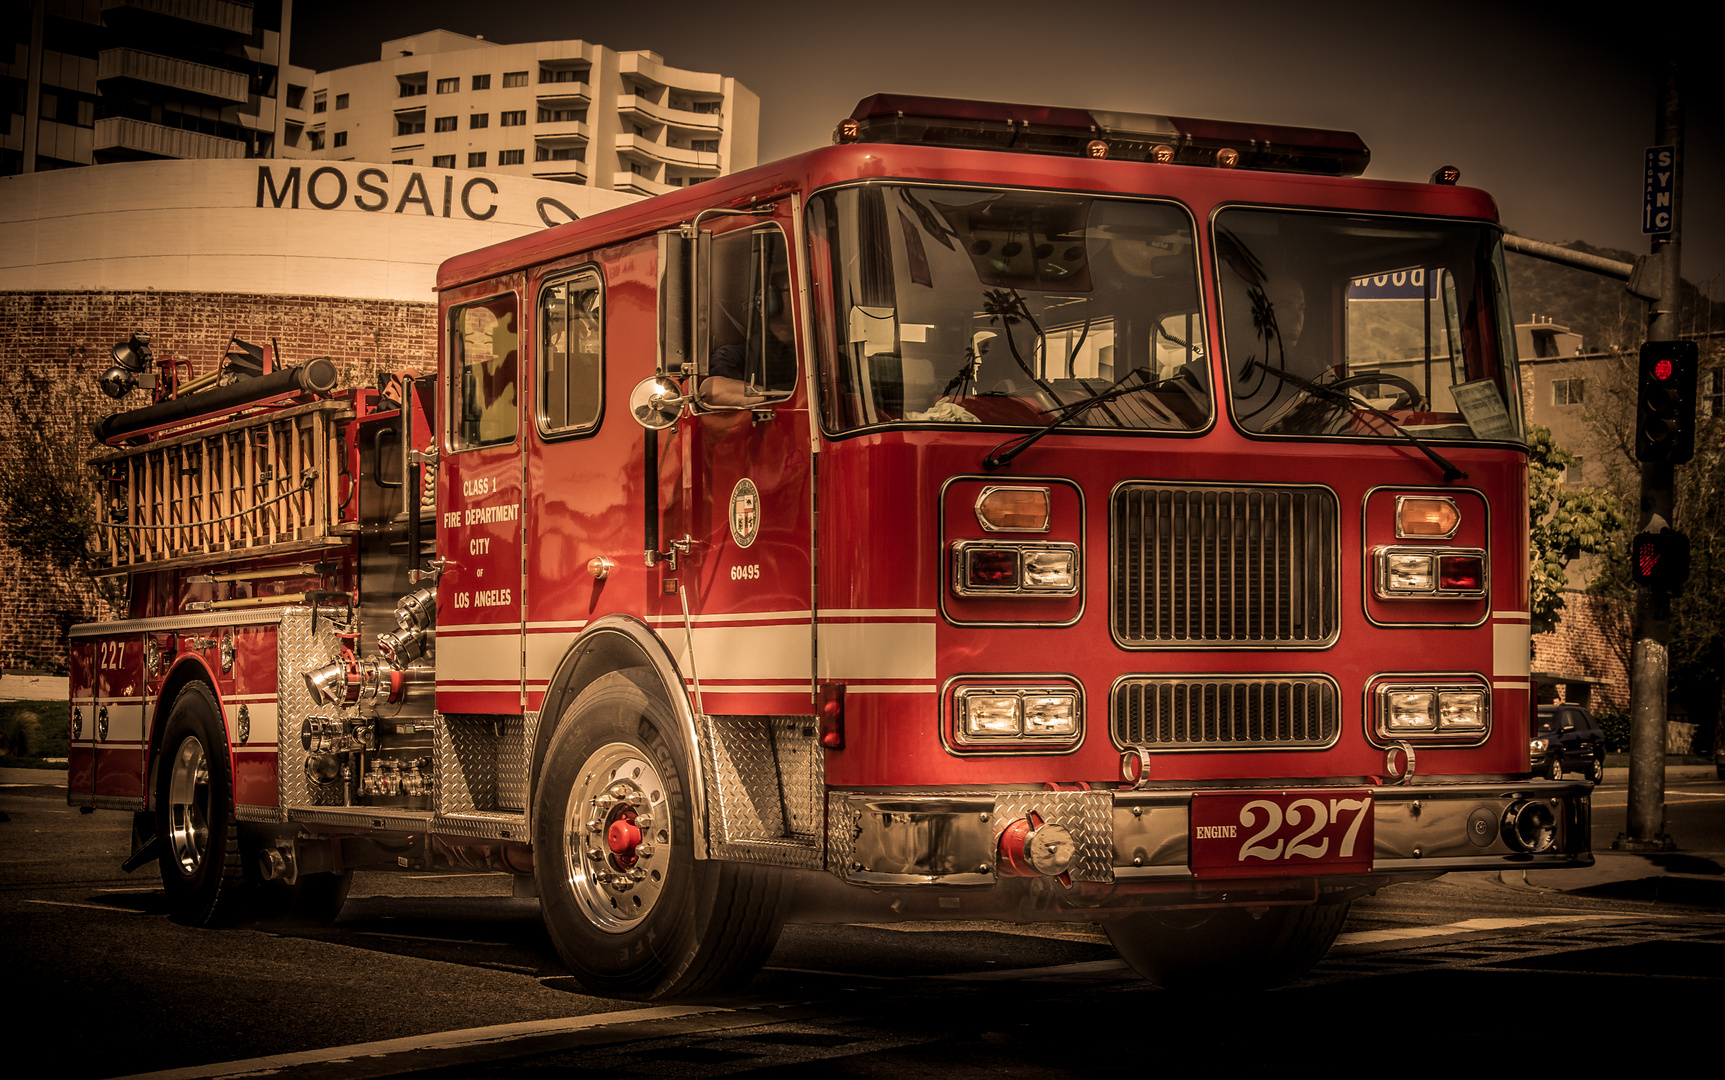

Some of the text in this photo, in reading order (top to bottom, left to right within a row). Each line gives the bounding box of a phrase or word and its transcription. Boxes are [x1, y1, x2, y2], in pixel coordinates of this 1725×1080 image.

[256, 165, 499, 221] MOSAIC
[1655, 151, 1671, 228] SYNC
[463, 476, 497, 497] CLASS 1
[443, 503, 520, 529] FIRE DEPARTMENT
[469, 537, 490, 556] CITY
[476, 568, 484, 578] OF
[730, 564, 760, 581] 60495
[454, 588, 512, 609] LOS ANGELES
[101, 640, 125, 669] 227
[639, 716, 687, 845] MICHELIN
[1196, 797, 1372, 862] ENGINE 227
